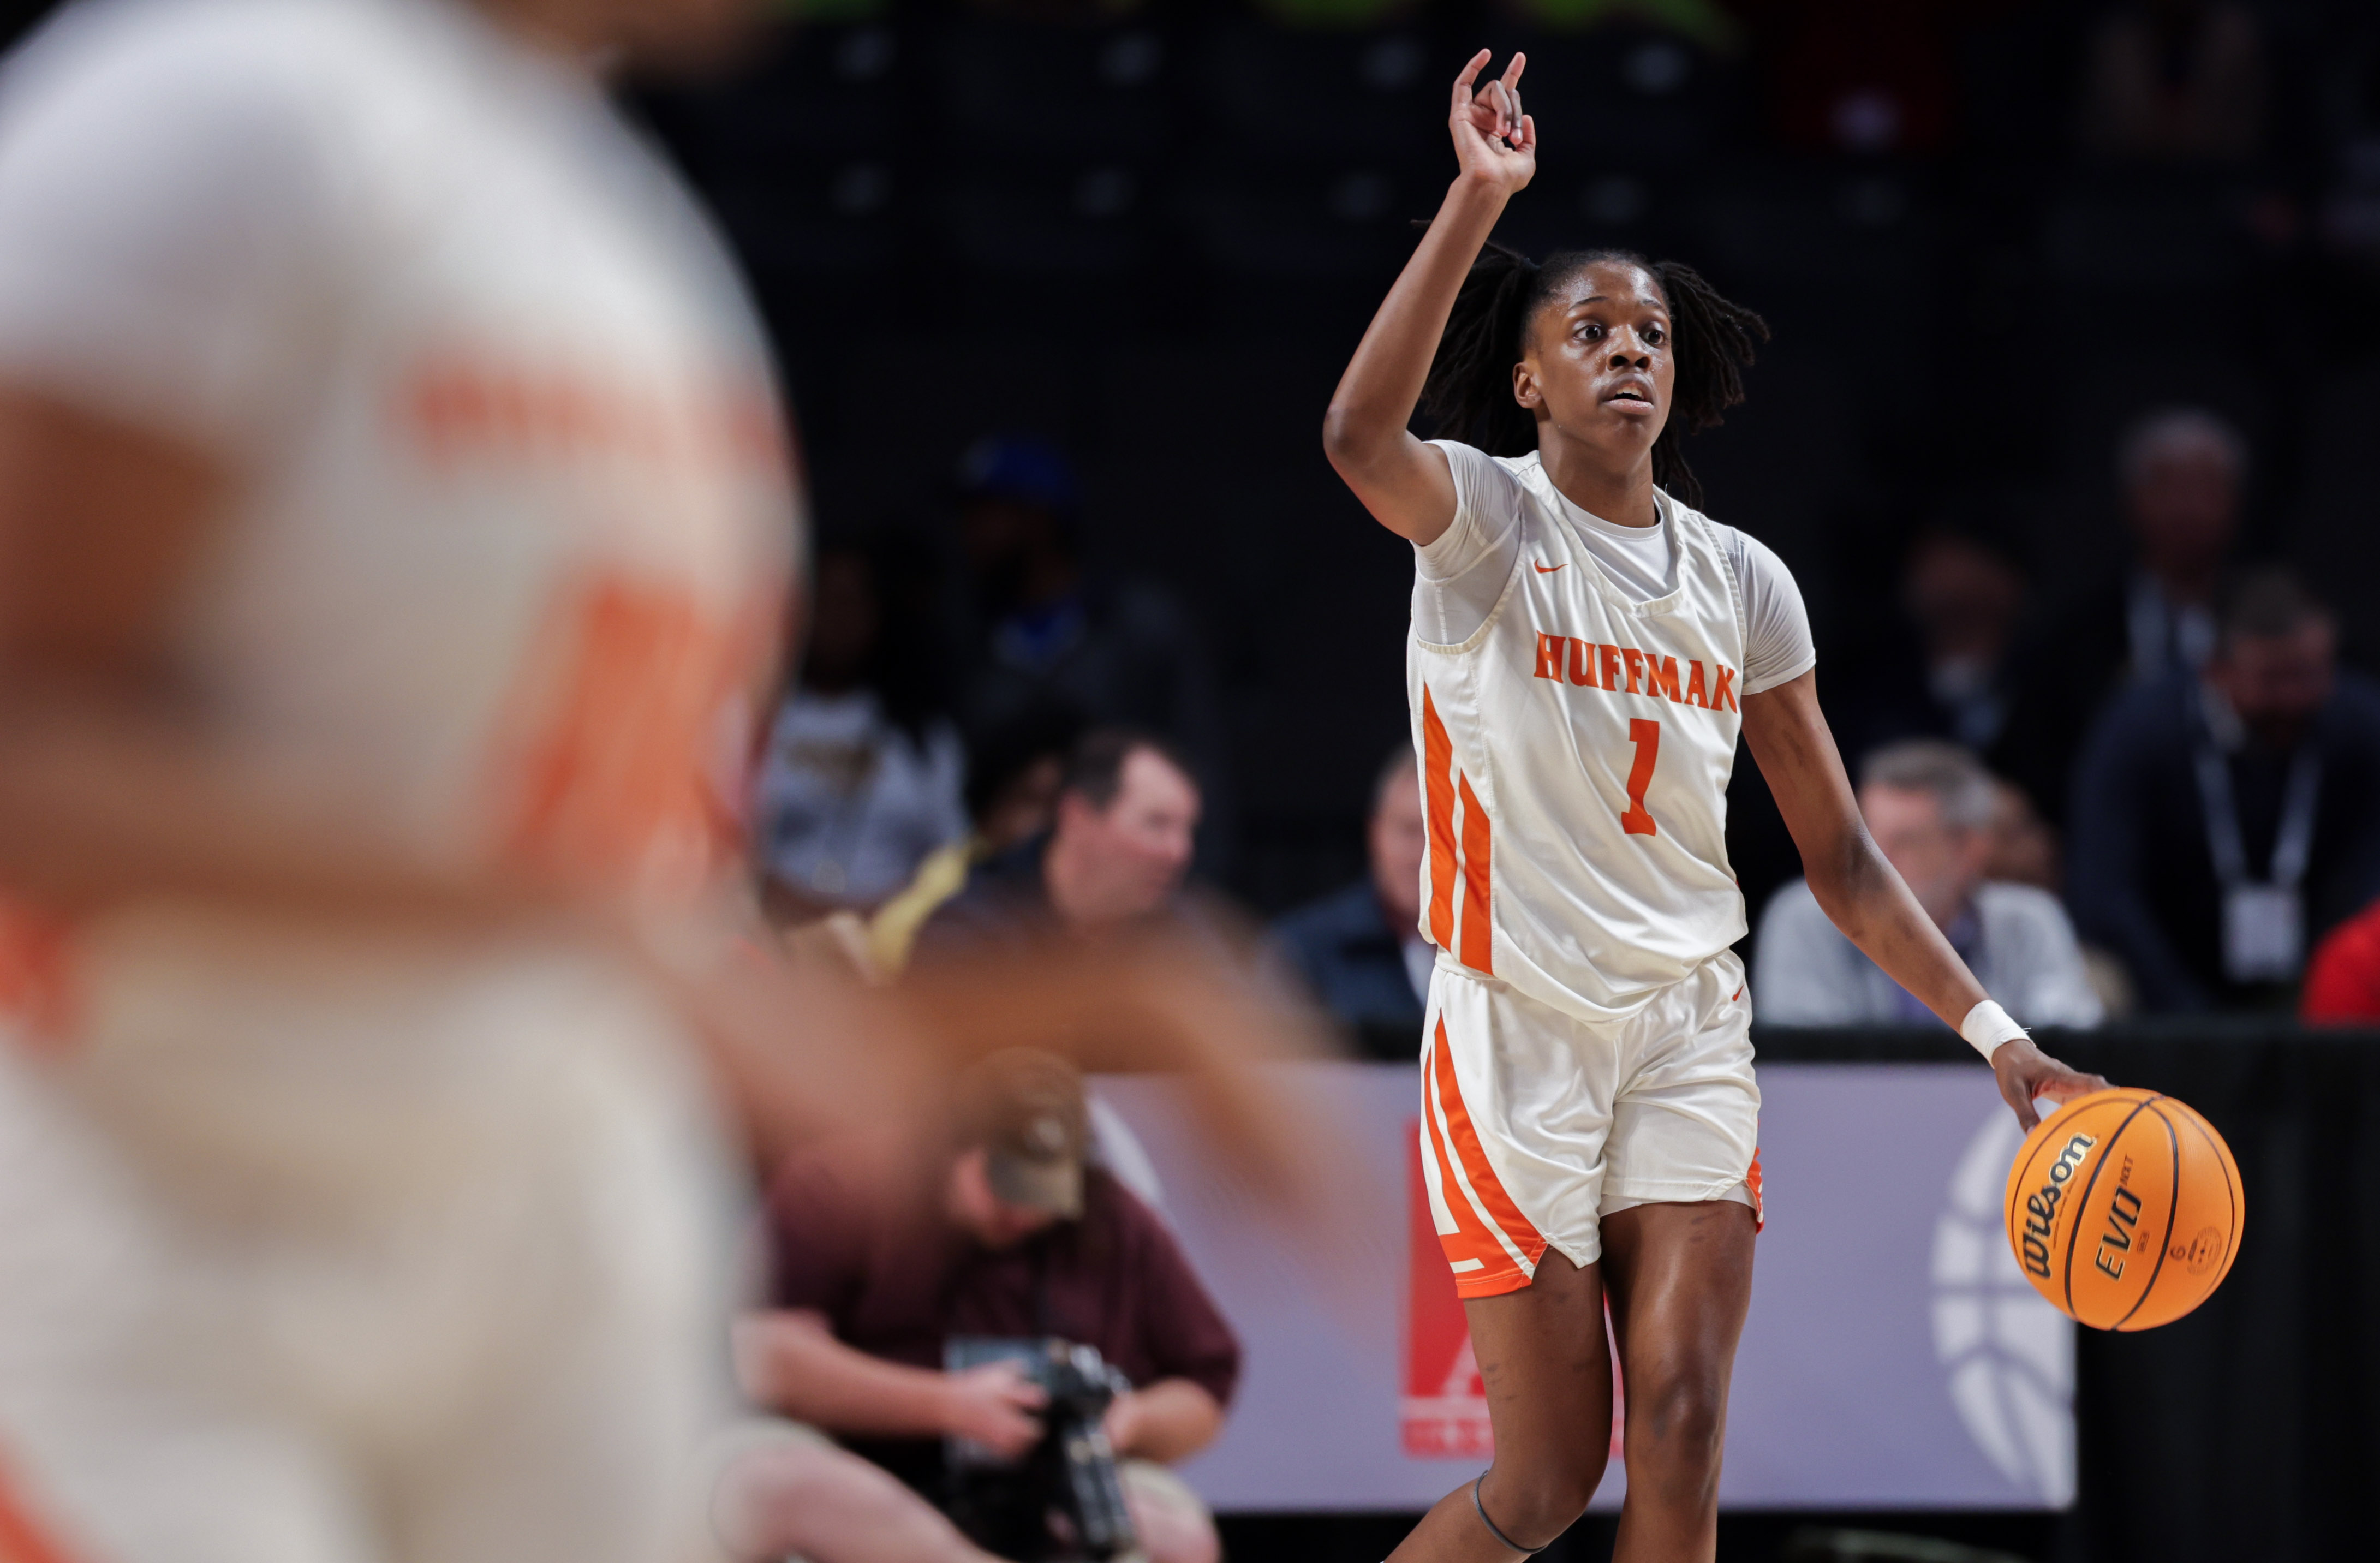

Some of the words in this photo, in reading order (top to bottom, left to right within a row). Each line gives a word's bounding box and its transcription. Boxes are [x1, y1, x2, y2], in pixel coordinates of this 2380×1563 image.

[1621, 718, 1660, 836] 1
[2021, 1132, 2097, 1280] Wilson
[2095, 1184, 2142, 1281] EVO
